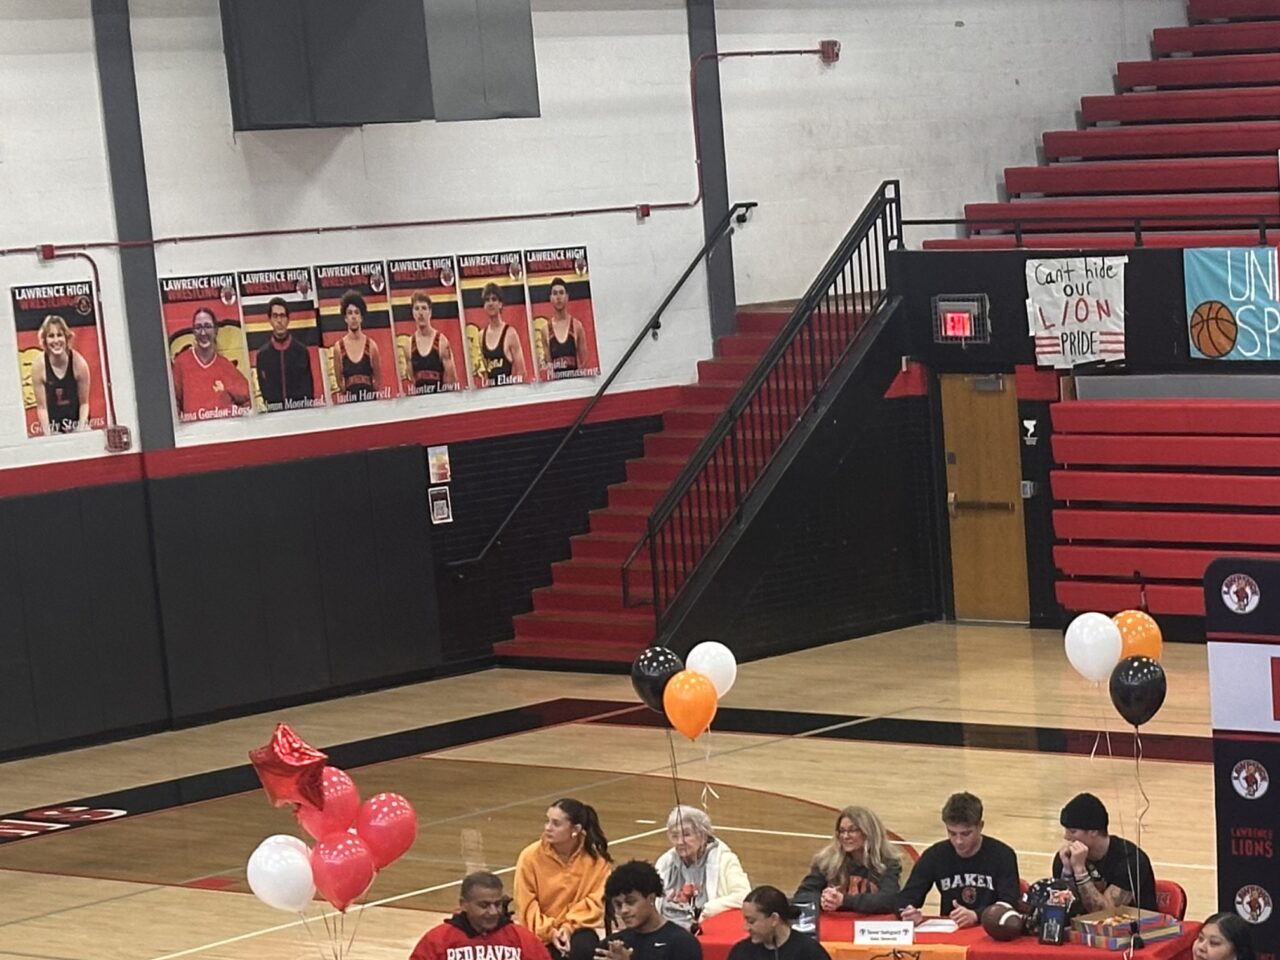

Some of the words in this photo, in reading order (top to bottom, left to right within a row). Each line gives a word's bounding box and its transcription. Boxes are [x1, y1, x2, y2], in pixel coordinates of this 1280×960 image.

[459, 254, 499, 267] LAWRENCE
[500, 253, 520, 264] HIGH
[526, 249, 564, 262] LAWRENCE
[565, 248, 585, 260] HIGH
[317, 264, 361, 278] LAWRENCE
[361, 263, 382, 275] HIGH
[389, 259, 431, 272] LAWRENCE
[432, 257, 452, 269] HIGH
[1034, 263, 1076, 286] Can't
[1084, 256, 1118, 280] hide
[163, 277, 210, 291] LAWRENCE
[210, 275, 233, 289] HIGH
[241, 271, 286, 286] LAWRENCE
[287, 269, 308, 282] HIGH
[15, 285, 65, 300] LAWRENCE
[66, 283, 90, 296] HIGH
[1063, 281, 1092, 298] our
[1038, 298, 1112, 331] LION
[1060, 331, 1098, 356] PRIDE
[358, 386, 391, 402] Harrell
[30, 418, 60, 434] Gdy
[1230, 827, 1273, 838] LAWRENCE
[1231, 839, 1274, 859] LIONS
